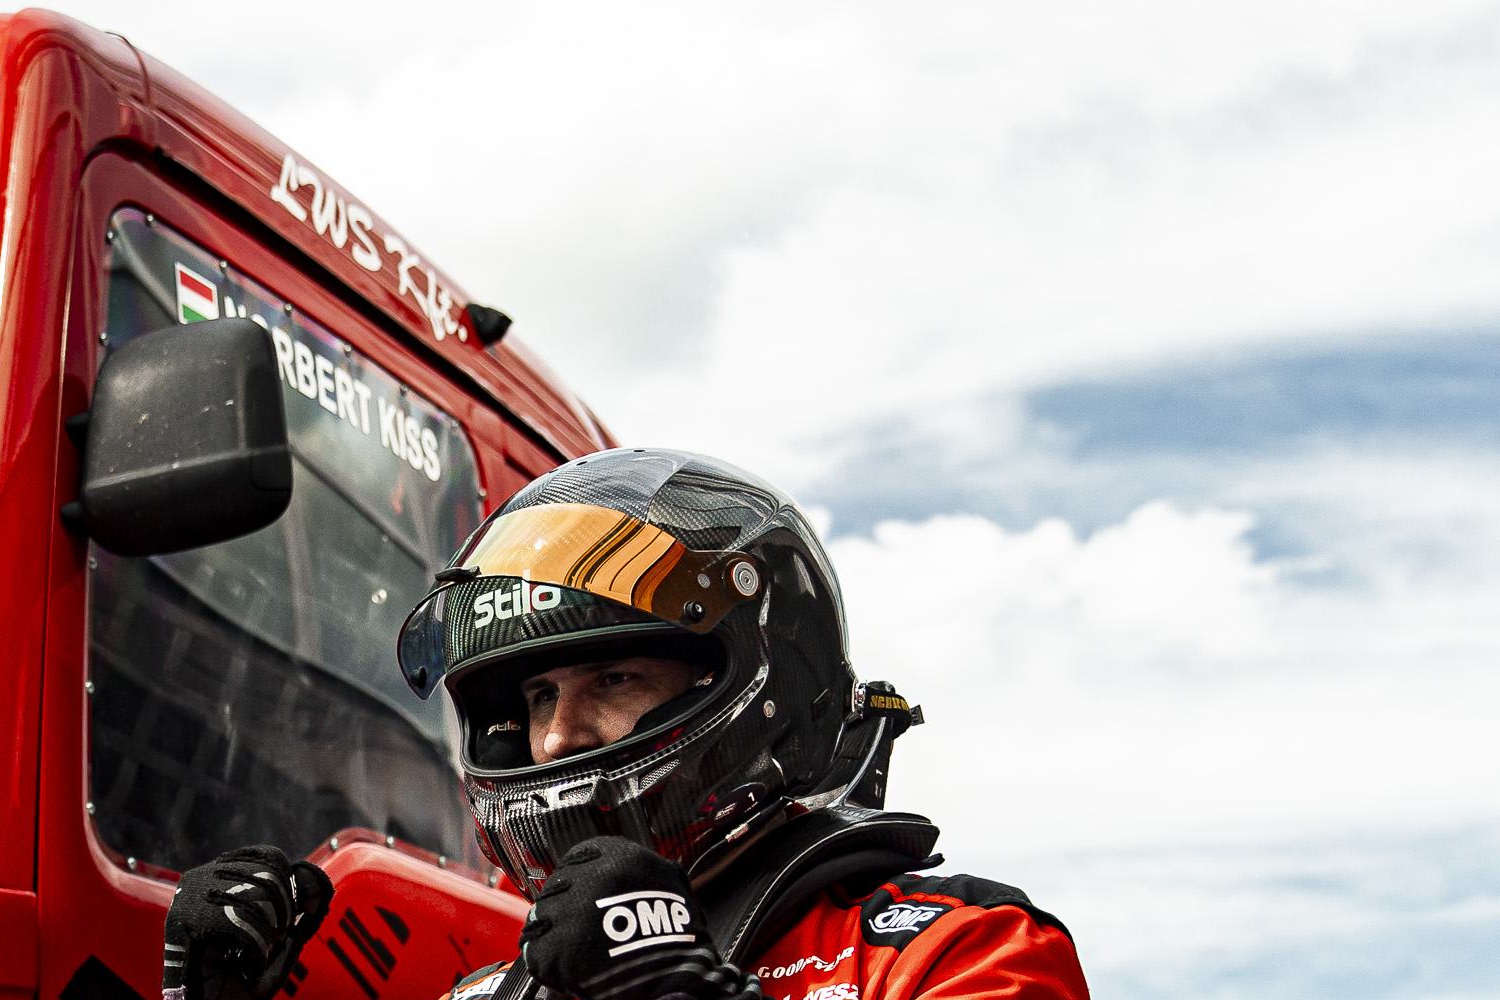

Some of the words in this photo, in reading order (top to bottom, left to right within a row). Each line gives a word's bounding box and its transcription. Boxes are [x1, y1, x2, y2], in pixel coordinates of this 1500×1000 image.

[223, 295, 373, 436] RBERT
[377, 396, 442, 482] KISS
[473, 569, 562, 630] stilo
[602, 899, 691, 943] OMP
[874, 908, 936, 930] OMP
